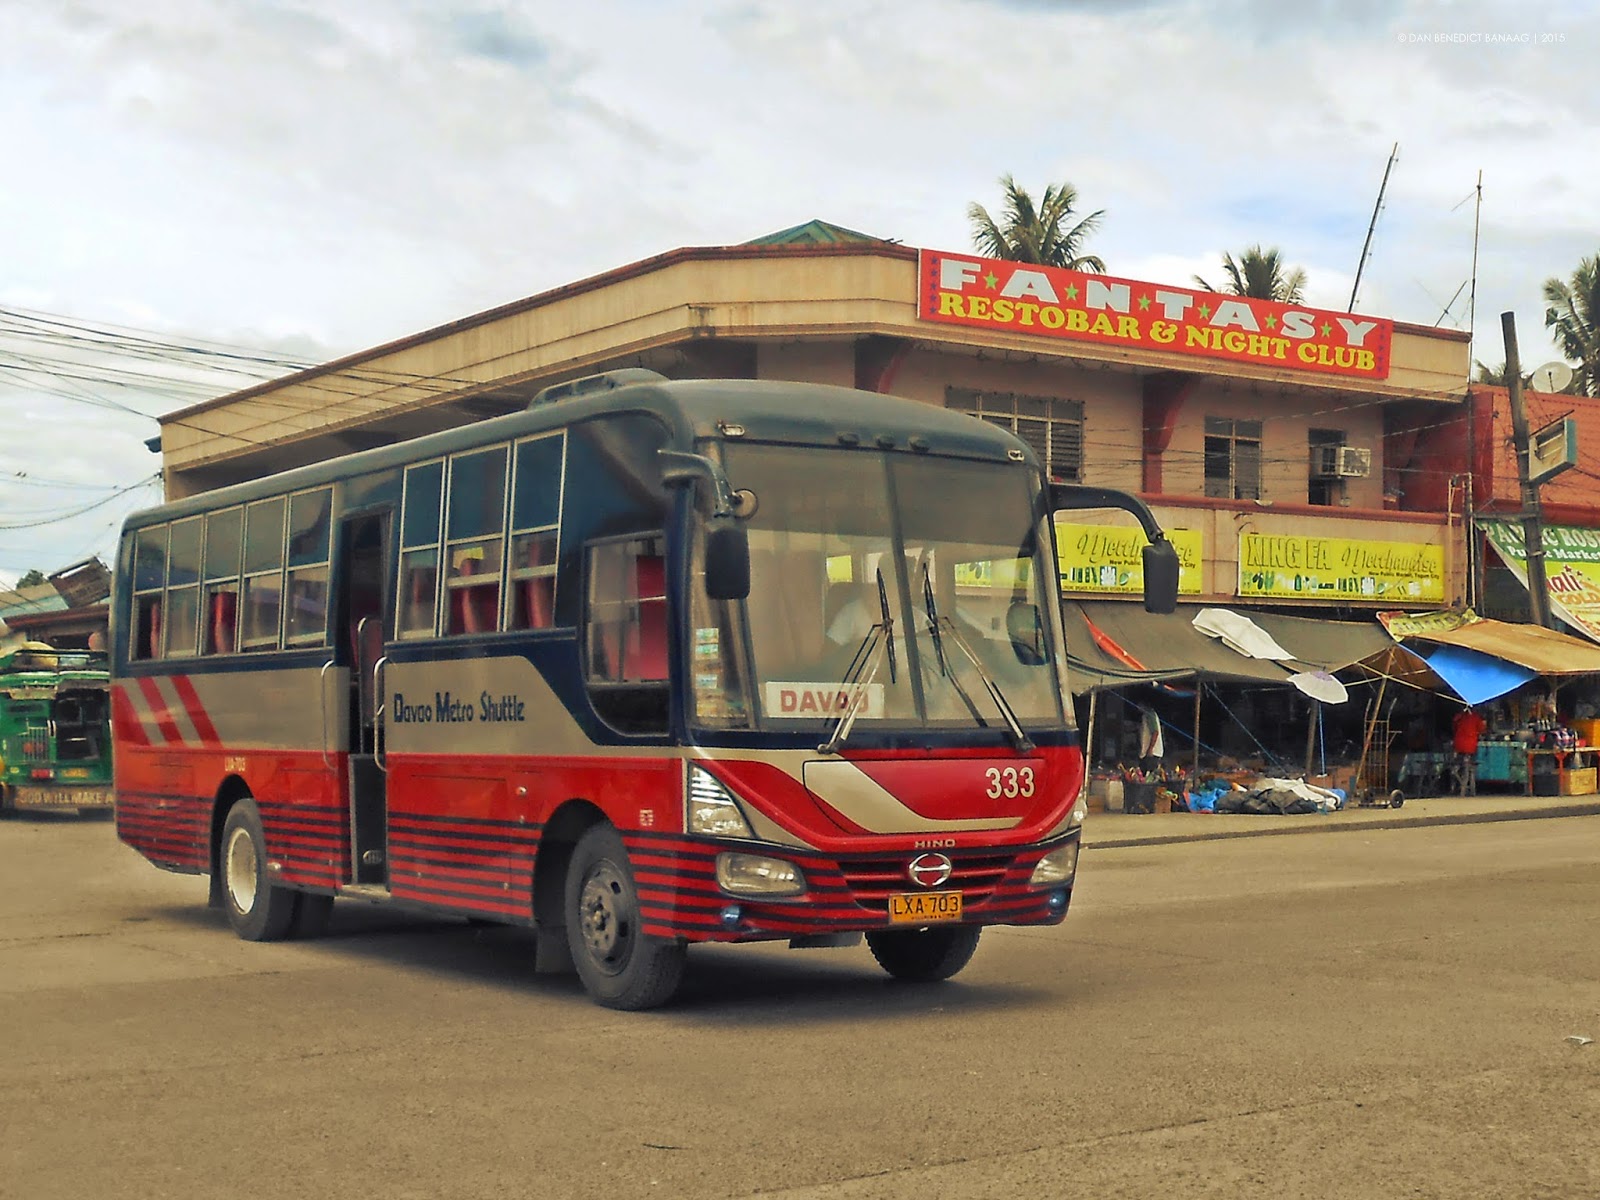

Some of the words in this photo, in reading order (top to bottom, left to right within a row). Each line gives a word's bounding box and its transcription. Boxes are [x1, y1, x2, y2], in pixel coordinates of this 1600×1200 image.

[939, 258, 1378, 347] FANTASY
[937, 291, 1141, 341] RESTOBAR
[1149, 320, 1178, 344] &
[1185, 324, 1291, 360] NIGHT
[1297, 342, 1376, 371] CLUB
[1247, 536, 1300, 569] XING
[393, 692, 432, 723] Davao
[435, 691, 474, 723] Metro
[479, 690, 525, 722] Shuttle
[985, 766, 1035, 800] 333
[914, 839, 956, 848] HINO
